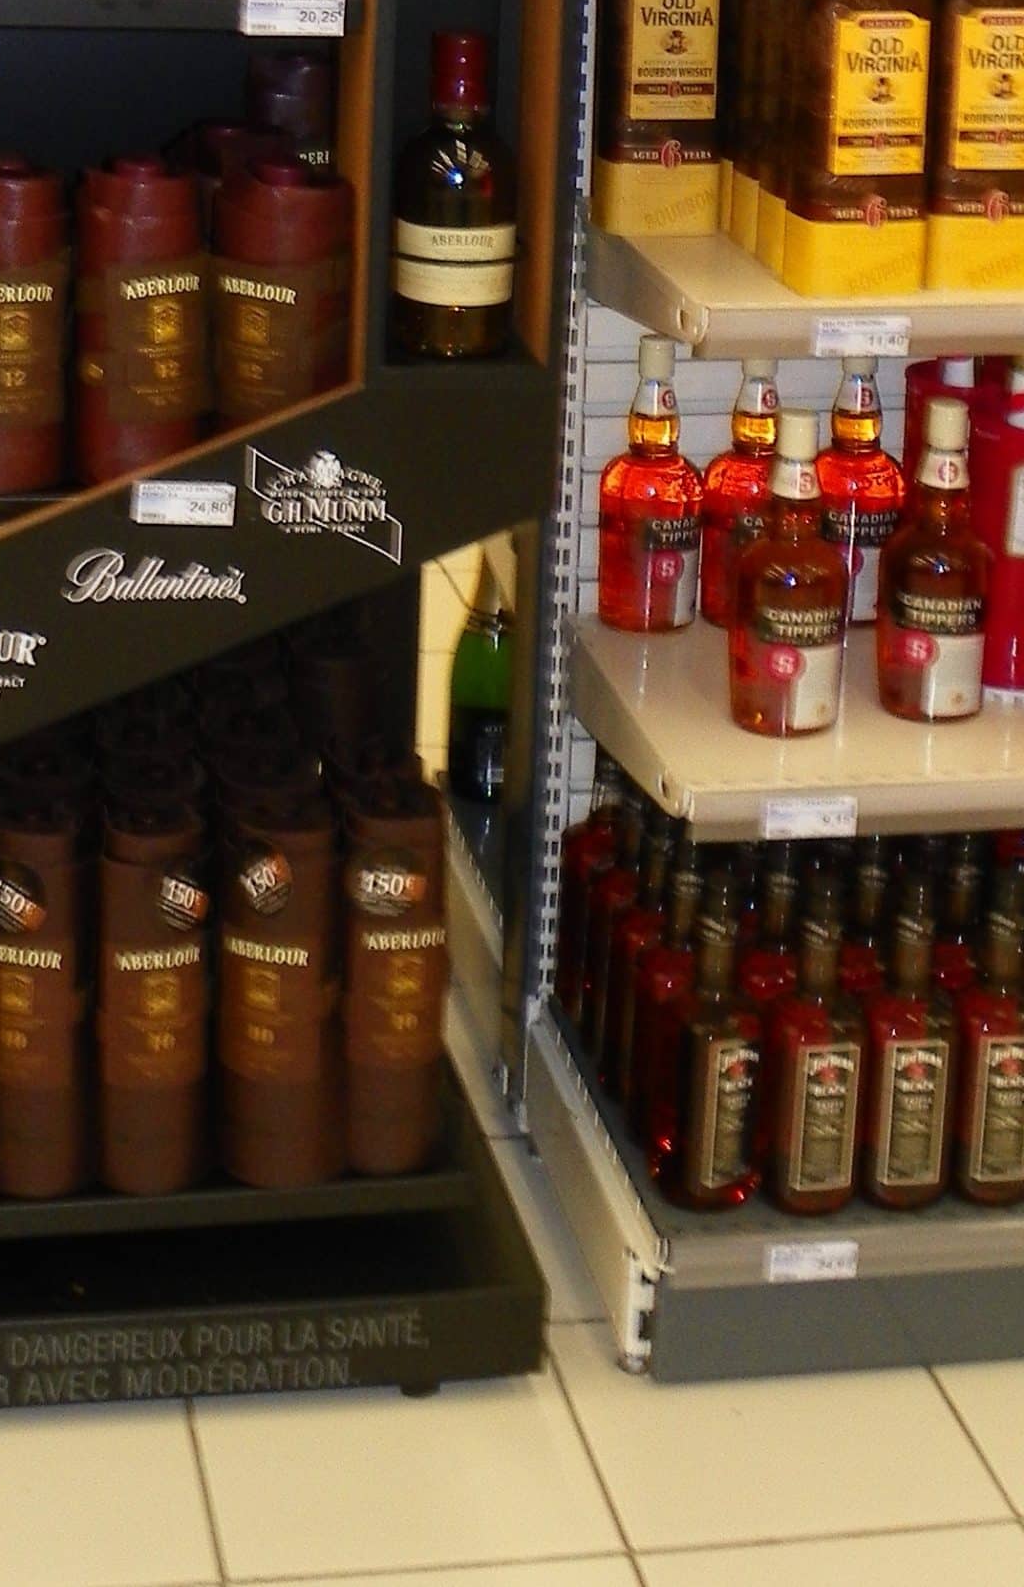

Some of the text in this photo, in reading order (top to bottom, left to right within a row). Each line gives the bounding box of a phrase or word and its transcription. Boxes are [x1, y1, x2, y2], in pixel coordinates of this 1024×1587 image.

[640, 7, 715, 27] VIRGINIA
[868, 37, 904, 55] OLD
[990, 34, 1024, 53] OLD
[846, 51, 924, 73] VIRGINIA
[637, 66, 713, 78] BOURBON WHISKEY
[632, 149, 659, 160] AGED
[683, 149, 712, 160] YEARS
[834, 207, 863, 220] AGED
[890, 207, 919, 219] YEARS
[957, 202, 984, 215] AGED
[431, 234, 496, 249] ABERLOUR
[123, 273, 201, 301] ABERLOUR
[222, 276, 298, 305] ABERLOUR
[61, 548, 247, 603] Ballantine's
[902, 594, 982, 613] CANADIAN
[767, 608, 843, 625] CANADIAN
[909, 609, 977, 626] TIPPERS
[775, 622, 838, 637] TIPPERS
[367, 929, 446, 951] ABERLOUR
[118, 946, 201, 971] ABERLOUR
[229, 937, 310, 967] ABERLOUR
[10, 1327, 184, 1366] DANGEREUX
[194, 1321, 274, 1356] POUR
[283, 1318, 319, 1353] LA
[24, 1368, 110, 1405] AVEC
